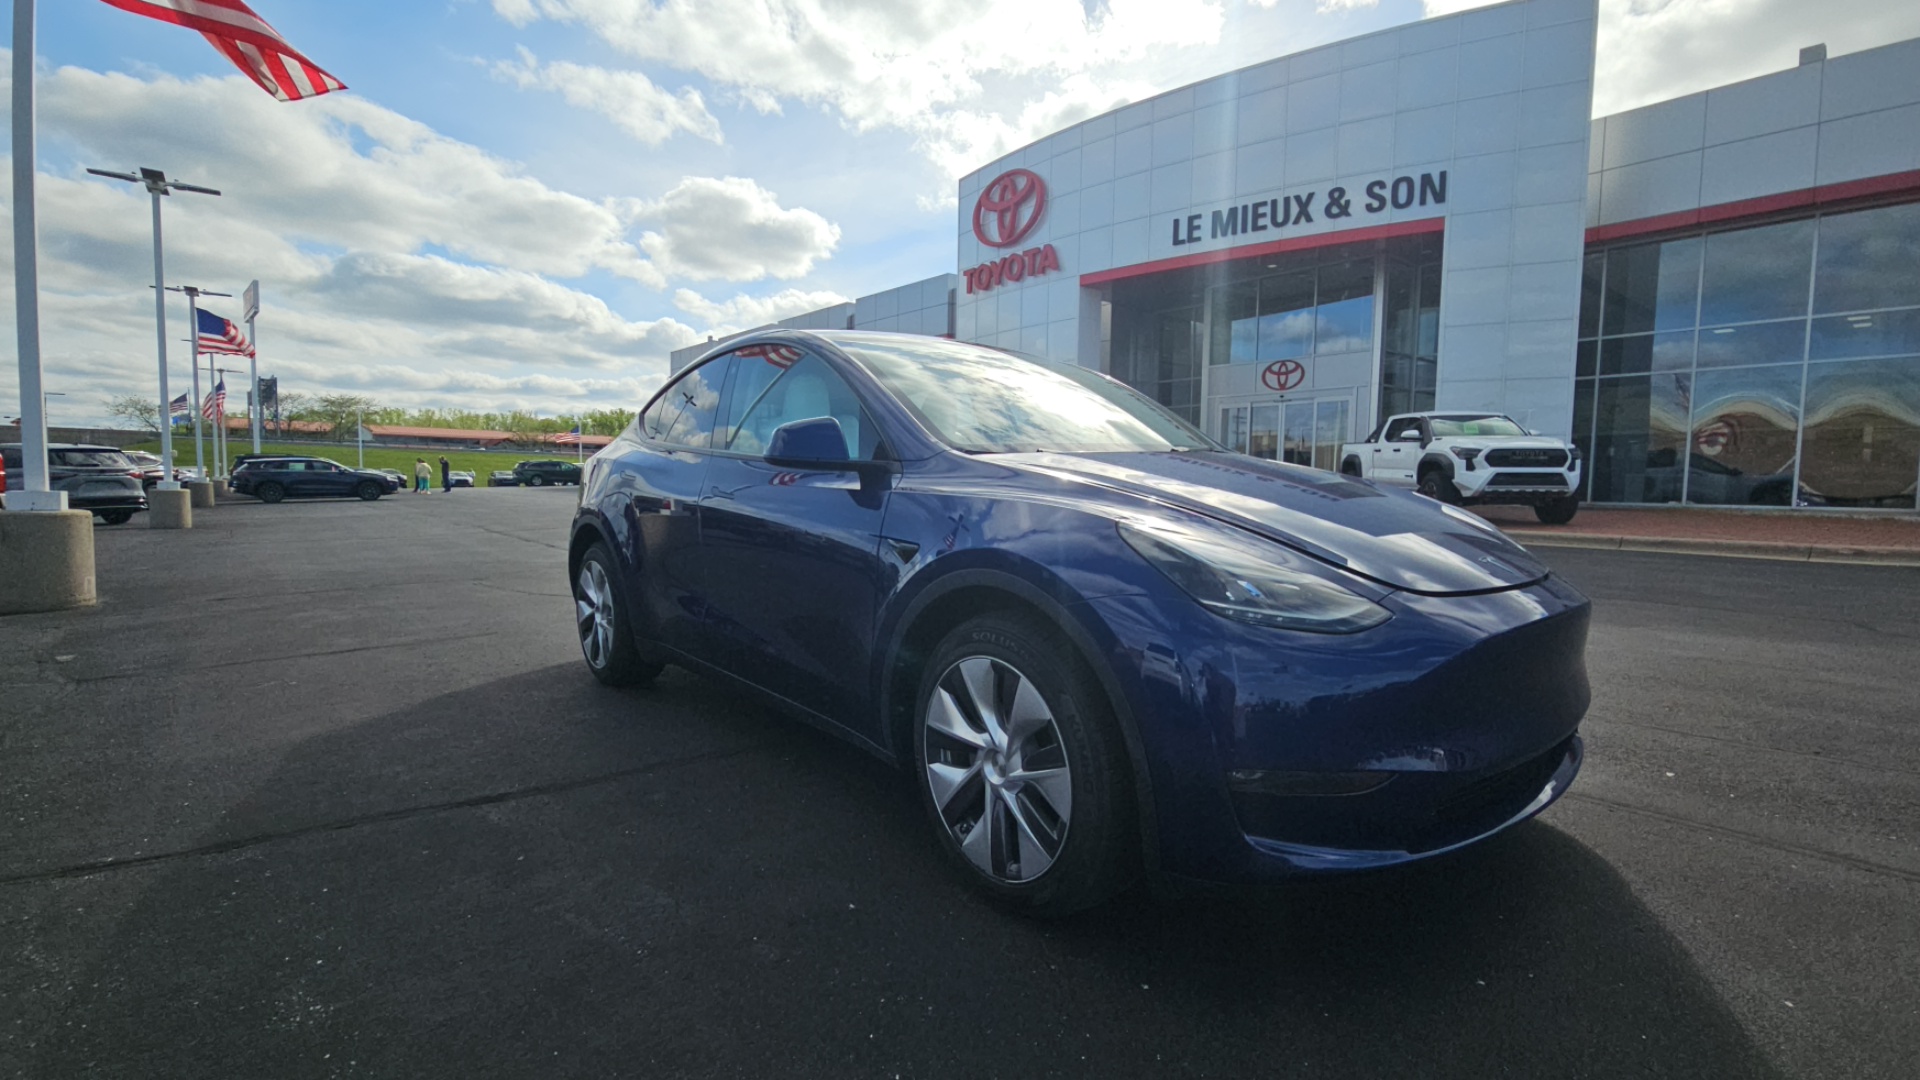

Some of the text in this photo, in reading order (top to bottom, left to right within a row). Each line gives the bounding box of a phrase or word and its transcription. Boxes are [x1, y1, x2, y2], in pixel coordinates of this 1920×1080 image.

[1172, 170, 1447, 246] LE MIEUX & SON
[963, 243, 1060, 295] TOYOTA
